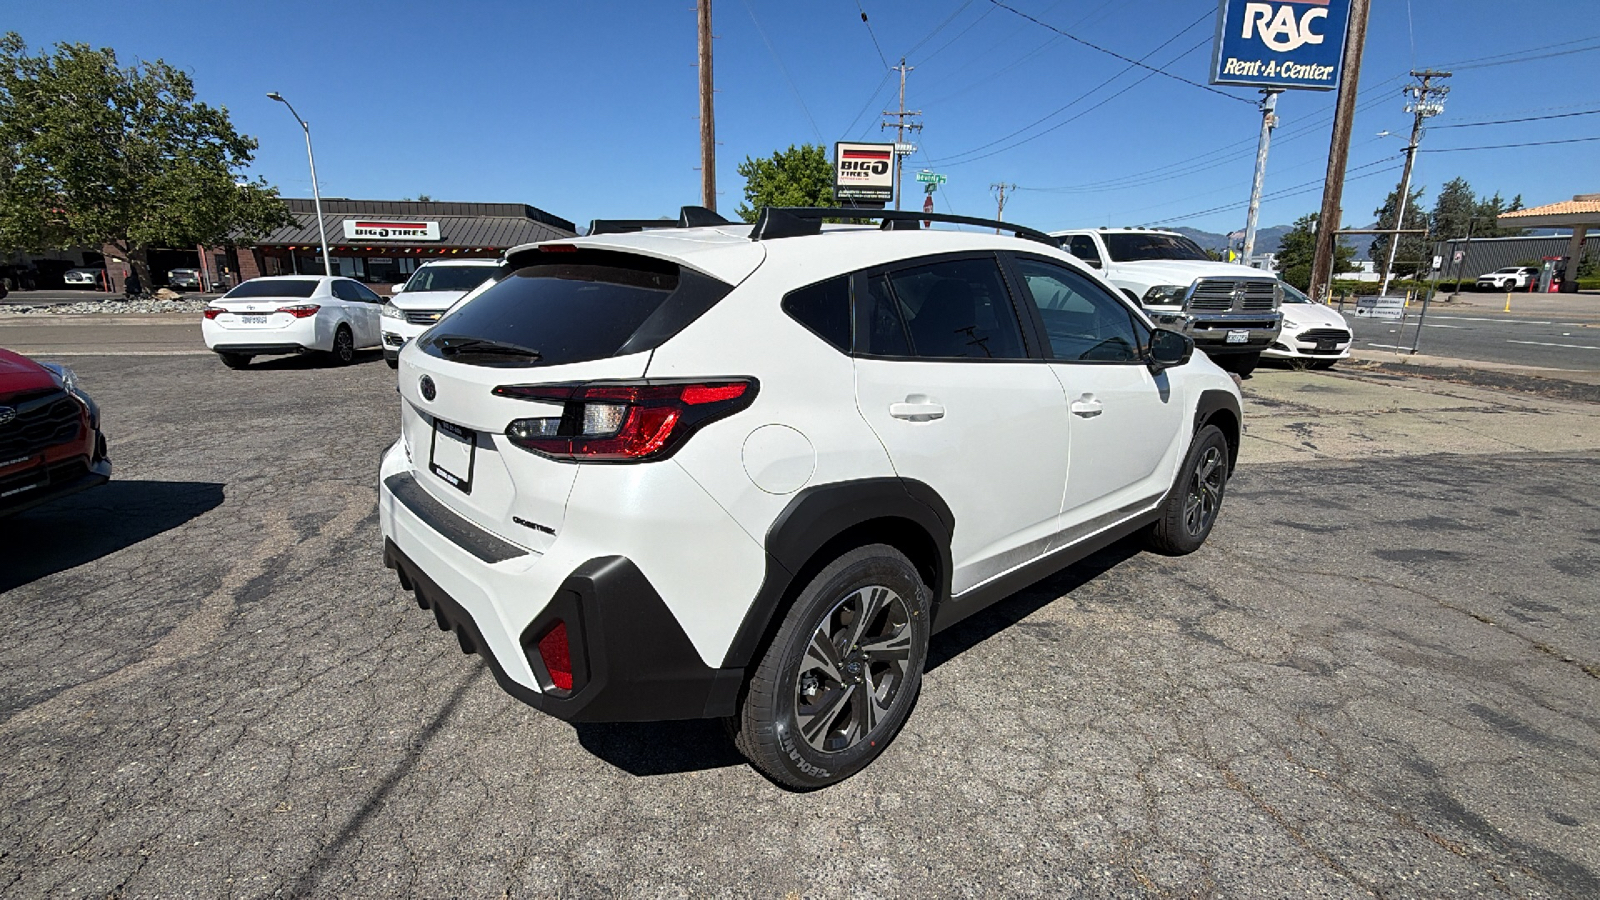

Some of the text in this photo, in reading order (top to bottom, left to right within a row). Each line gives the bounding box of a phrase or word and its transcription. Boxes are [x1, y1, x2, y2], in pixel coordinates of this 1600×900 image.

[1241, 3, 1329, 52] RAC
[840, 160, 888, 175] BIG O
[355, 228, 377, 236] BIG
